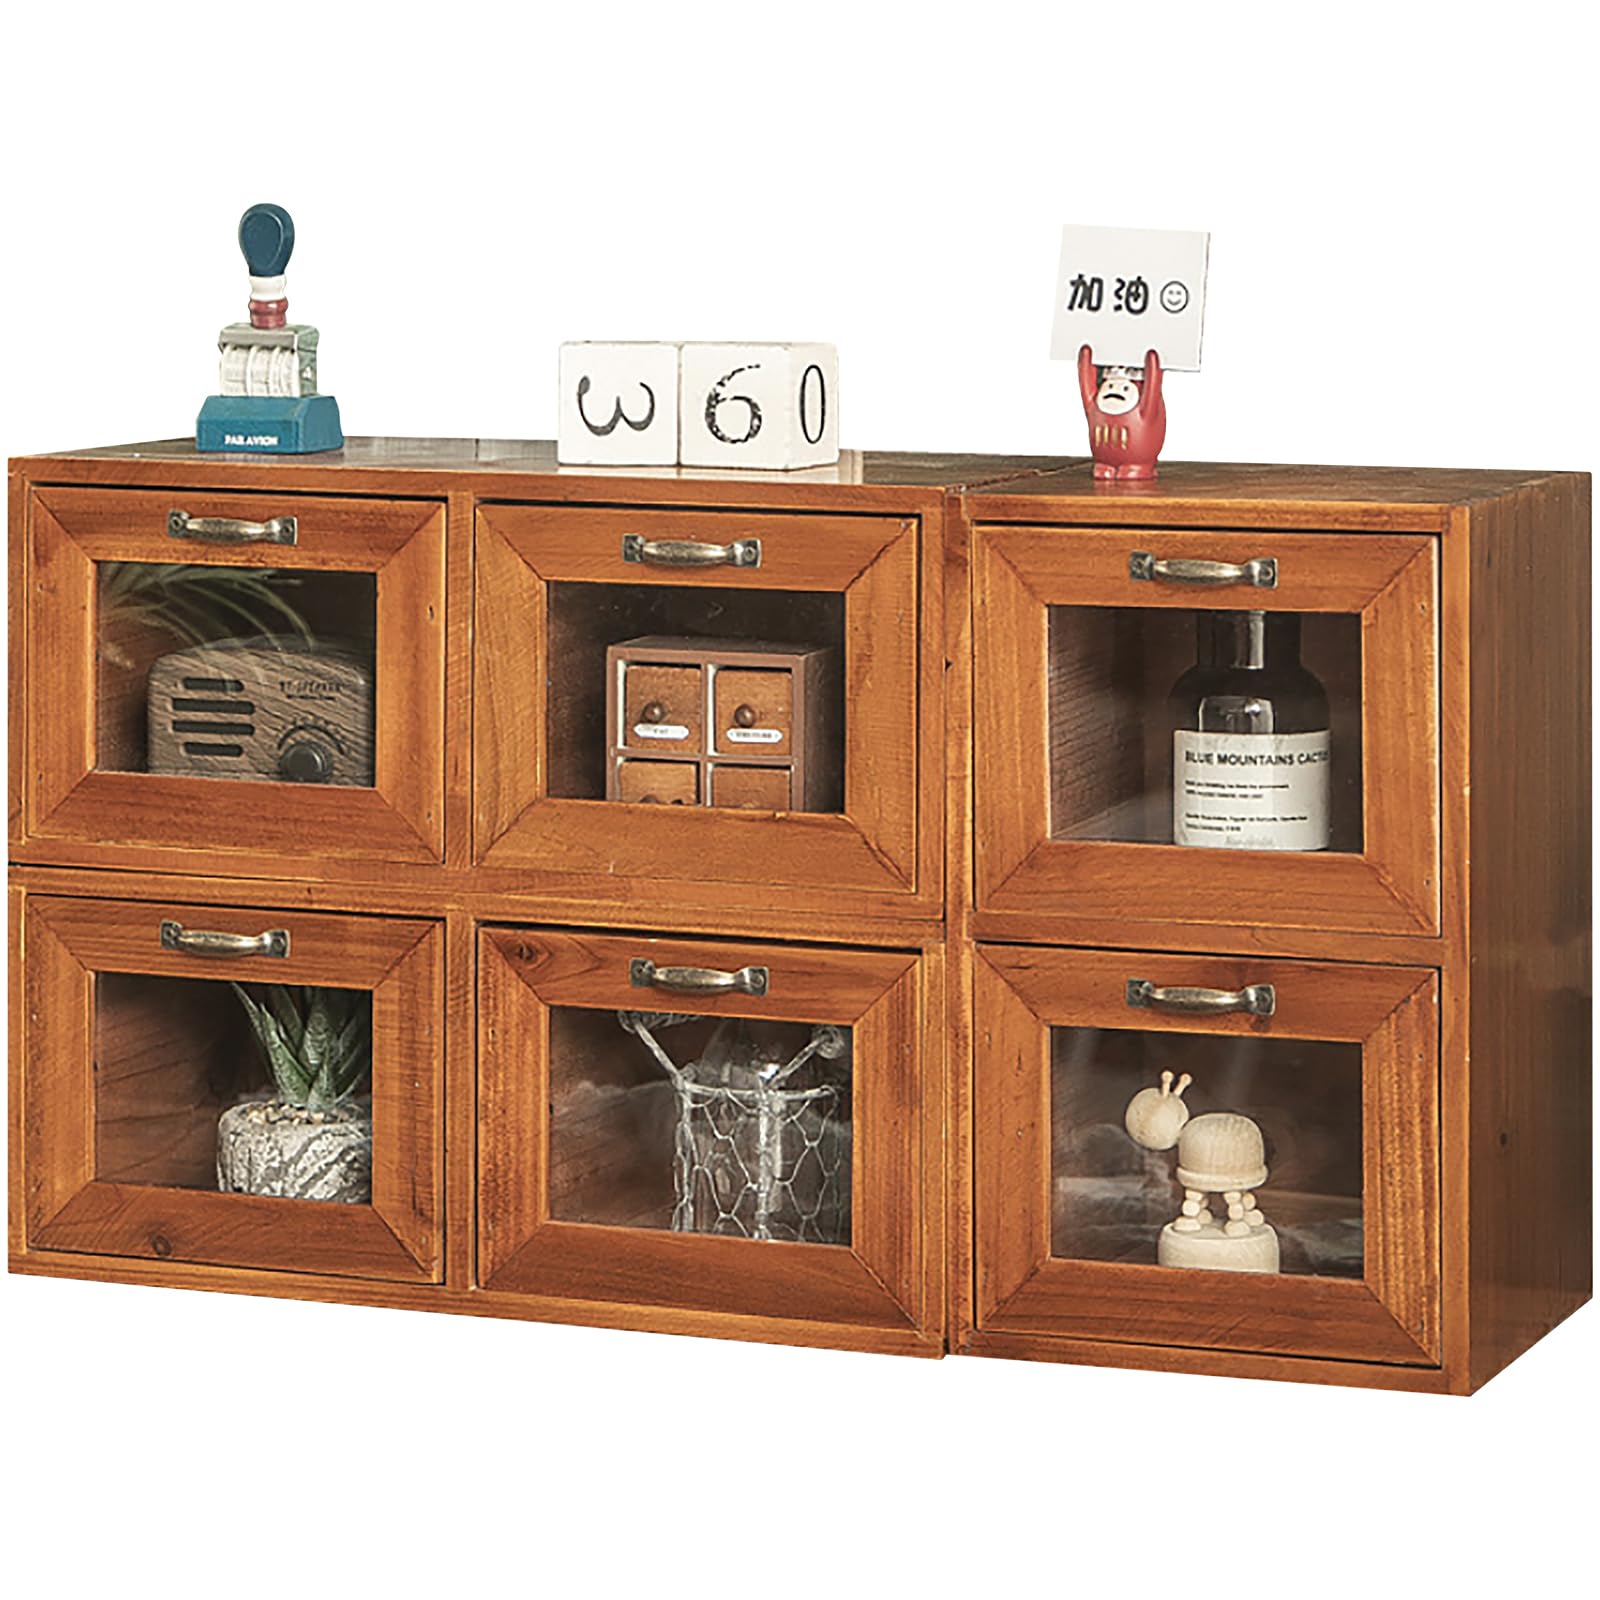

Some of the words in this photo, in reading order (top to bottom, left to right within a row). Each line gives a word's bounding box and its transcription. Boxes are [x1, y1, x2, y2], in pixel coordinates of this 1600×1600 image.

[1067, 273, 1149, 315] 加油
[704, 363, 762, 444] 6
[1185, 751, 1214, 765] BLUE
[1217, 753, 1295, 766] MOUNTAINS
